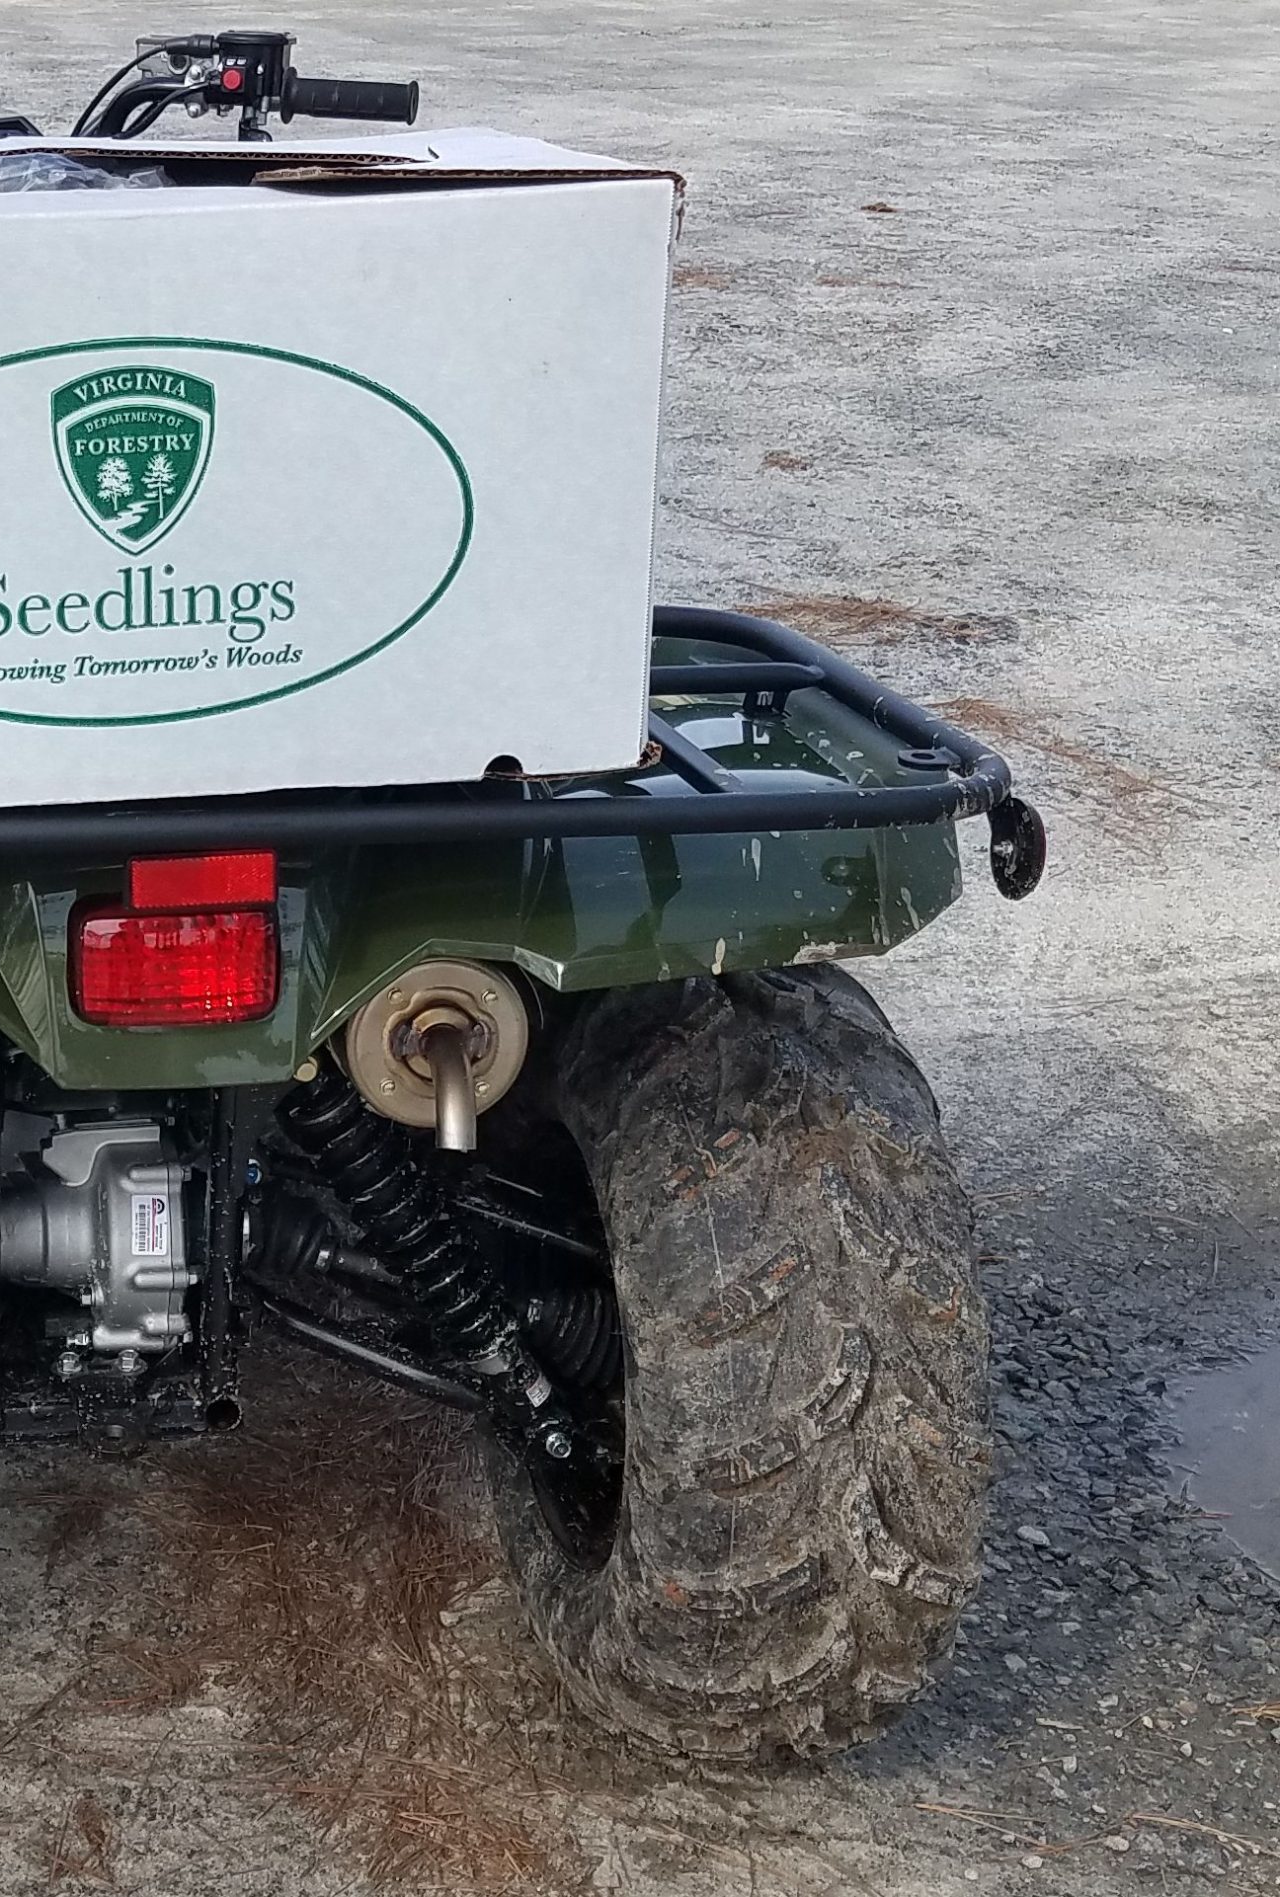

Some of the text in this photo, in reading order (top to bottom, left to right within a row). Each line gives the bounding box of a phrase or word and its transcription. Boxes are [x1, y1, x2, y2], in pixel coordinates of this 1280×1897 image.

[73, 373, 186, 402] VIRGINIA
[85, 411, 184, 432] DEPARTMENT OF
[74, 434, 195, 455] FORESTRY
[73, 649, 217, 677] Tomorrow's
[227, 643, 303, 667] Woods
